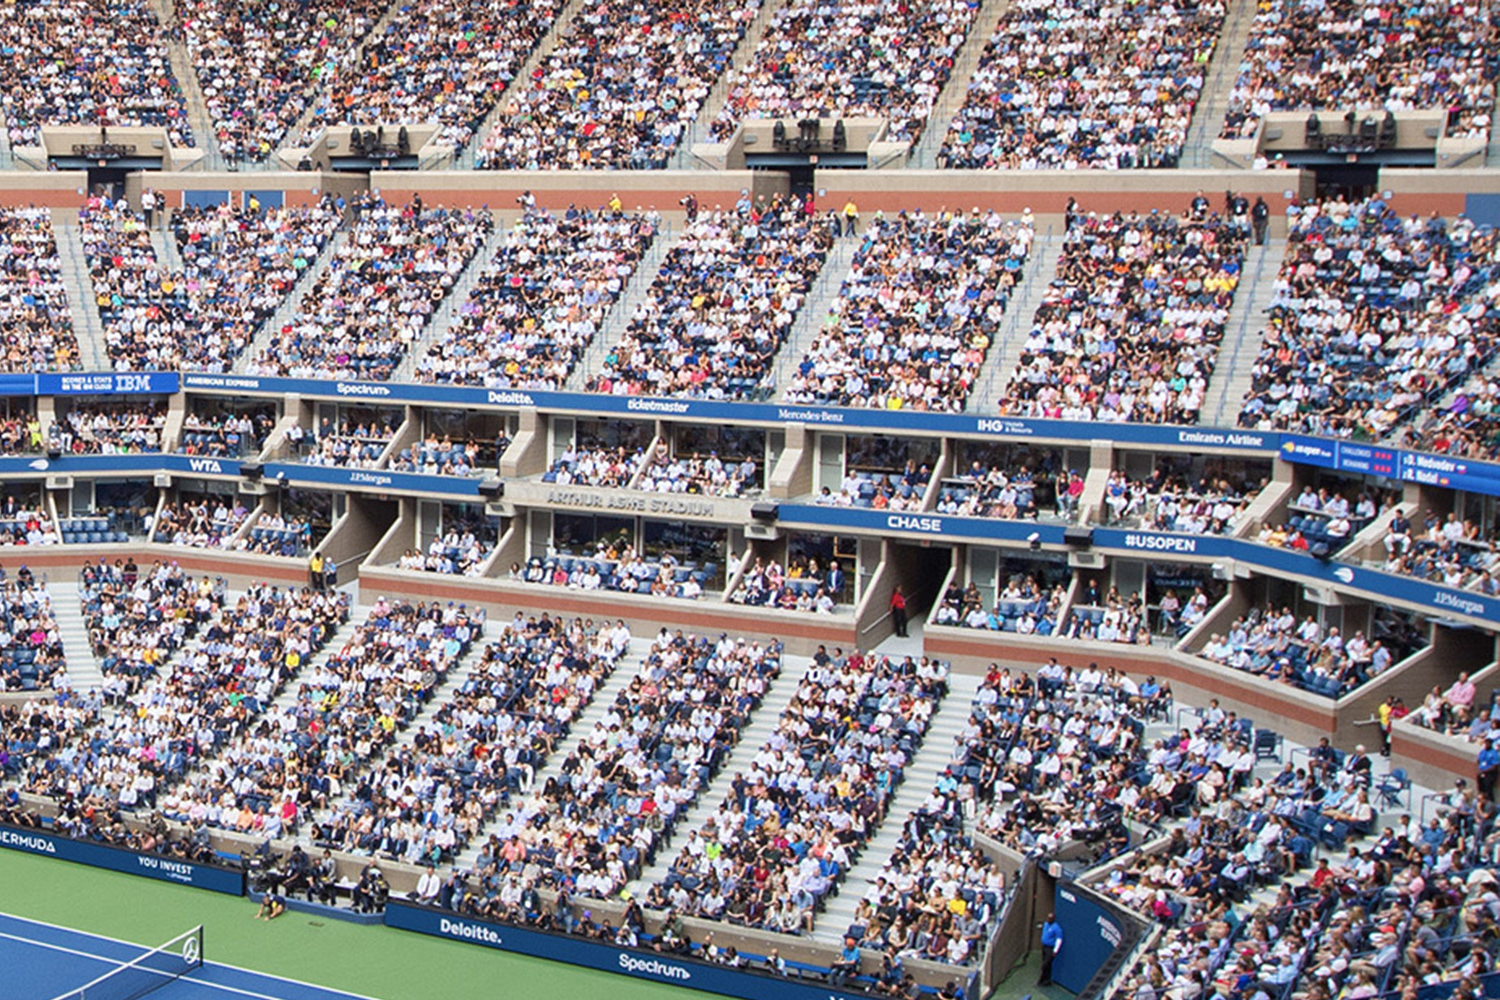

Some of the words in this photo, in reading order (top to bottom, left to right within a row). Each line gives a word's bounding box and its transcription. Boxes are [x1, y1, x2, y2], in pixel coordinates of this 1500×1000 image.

[115, 376, 150, 391] IBM
[187, 377, 224, 386] AMERICAN
[226, 379, 259, 388] EXPRESS
[337, 382, 386, 396] Spectrum
[488, 390, 533, 406] Deloitte.
[627, 399, 689, 414] ticketmaster
[779, 407, 844, 422] Mercedes-Benz
[978, 419, 1002, 432] IHG
[1179, 430, 1223, 443] Emirates
[1226, 433, 1262, 446] Airline
[190, 458, 221, 473] WTA
[547, 491, 602, 508] ARTHUR
[607, 497, 646, 511] ASHE
[651, 500, 715, 517] STADIUM
[888, 515, 941, 532] CHASE
[1125, 534, 1196, 553] #USOPEN
[1434, 591, 1484, 614] J.P.Morgan
[138, 856, 158, 868] YOU
[160, 860, 192, 875] INVEST
[440, 918, 502, 945] Deloitte.
[618, 953, 684, 978] Spectrum
